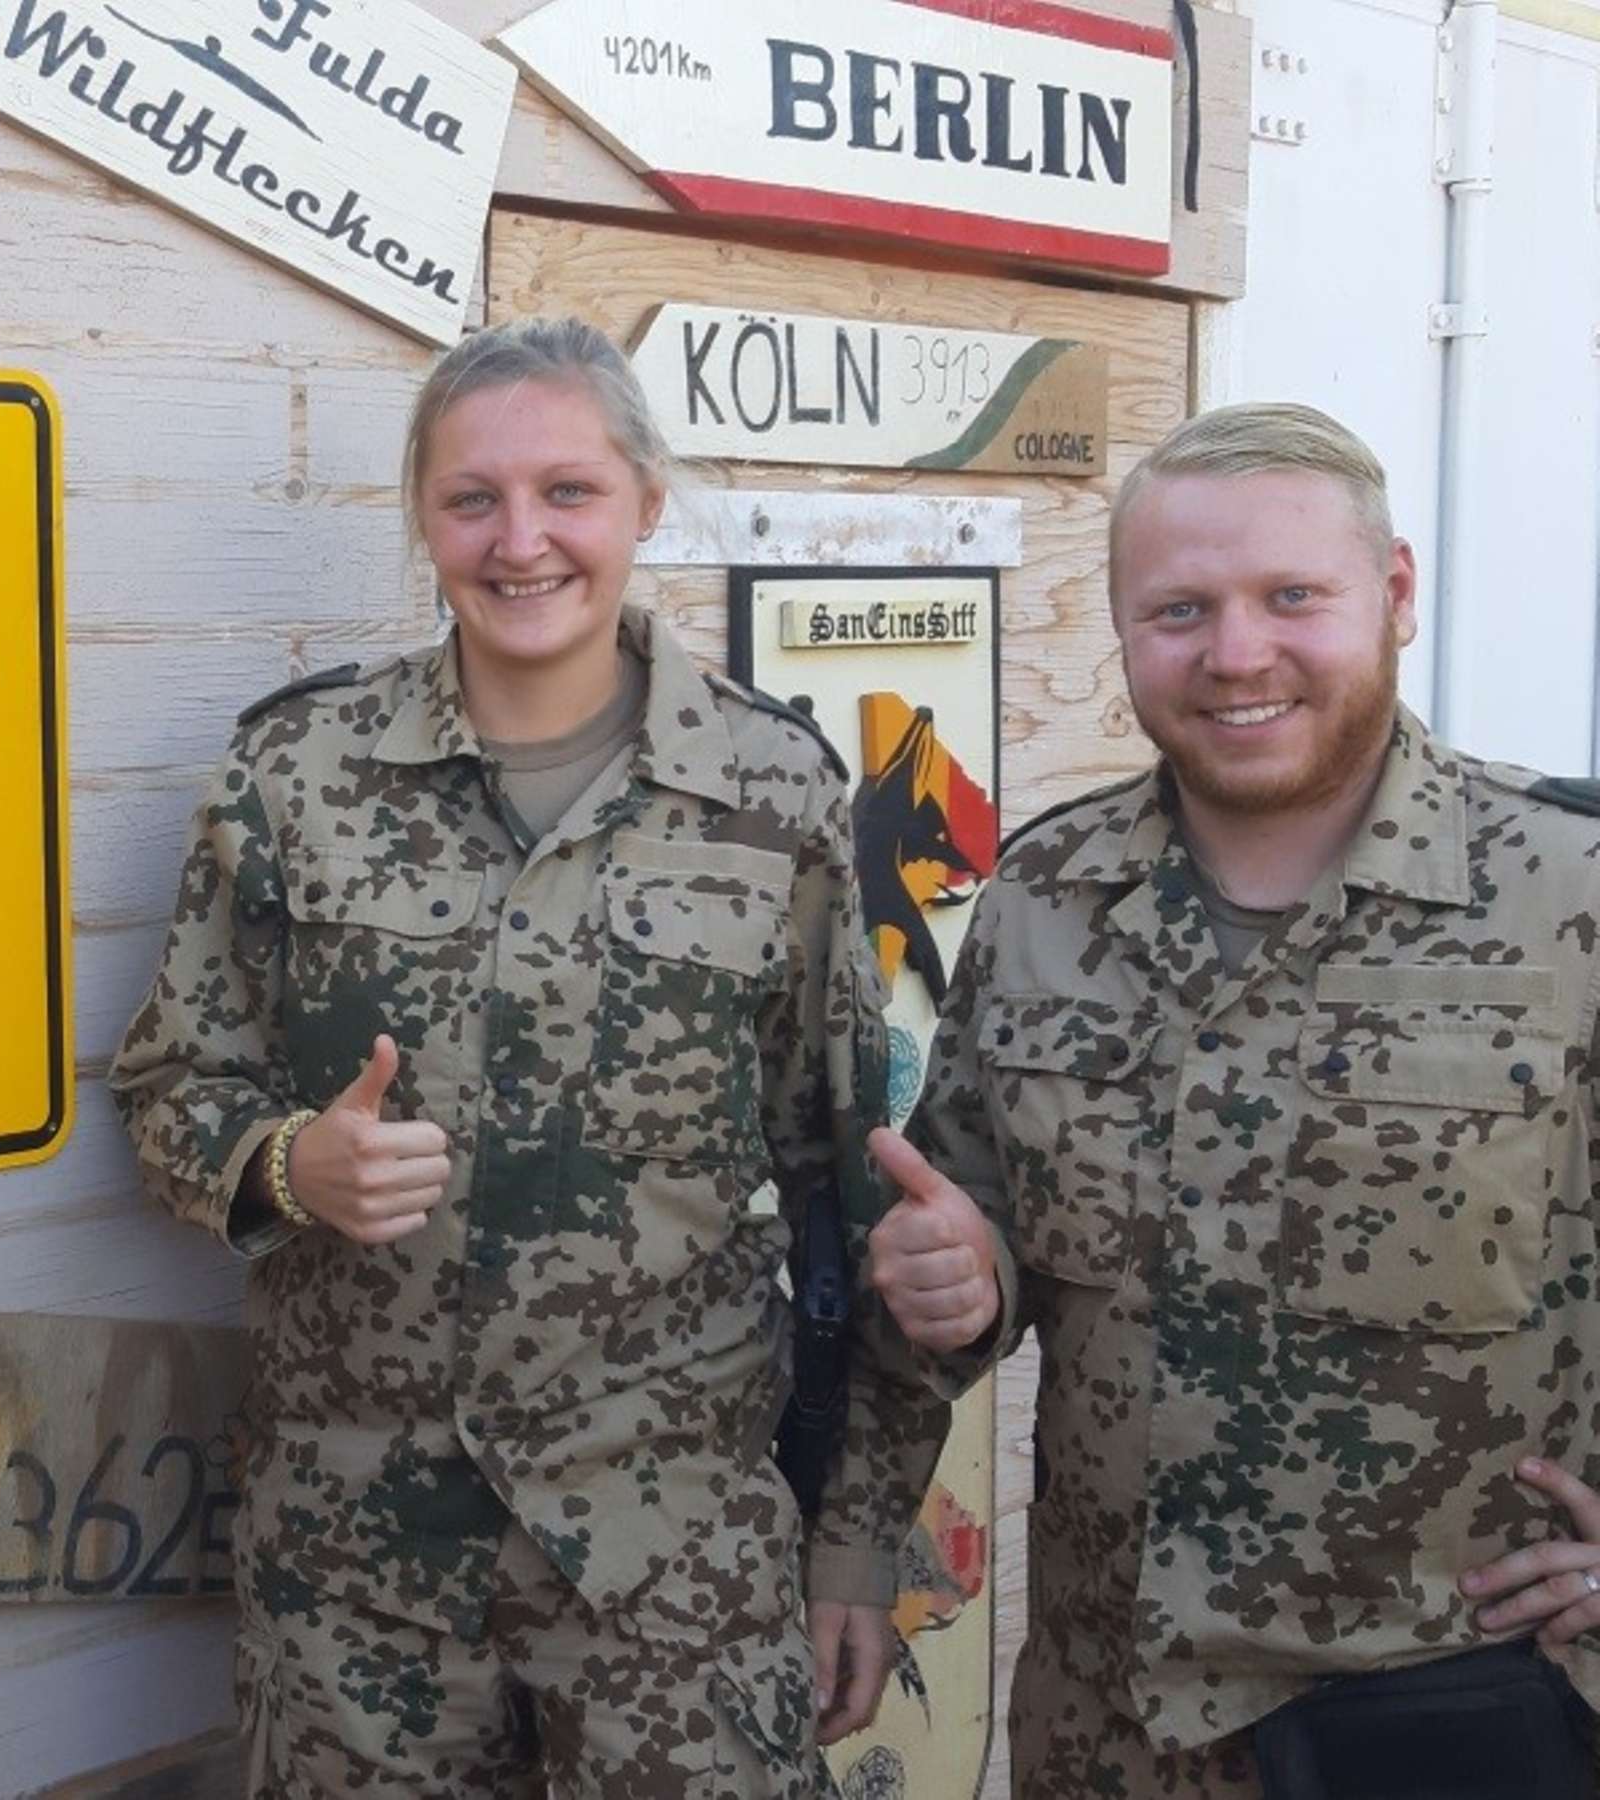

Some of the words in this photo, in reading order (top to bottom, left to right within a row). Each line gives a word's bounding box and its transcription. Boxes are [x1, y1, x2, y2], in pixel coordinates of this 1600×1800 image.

[251, 0, 465, 156] Fulda
[766, 38, 1132, 185] BERLIN
[682, 312, 881, 434] KÖLN
[901, 334, 992, 405] 3913
[1014, 431, 1095, 464] COLOGNE
